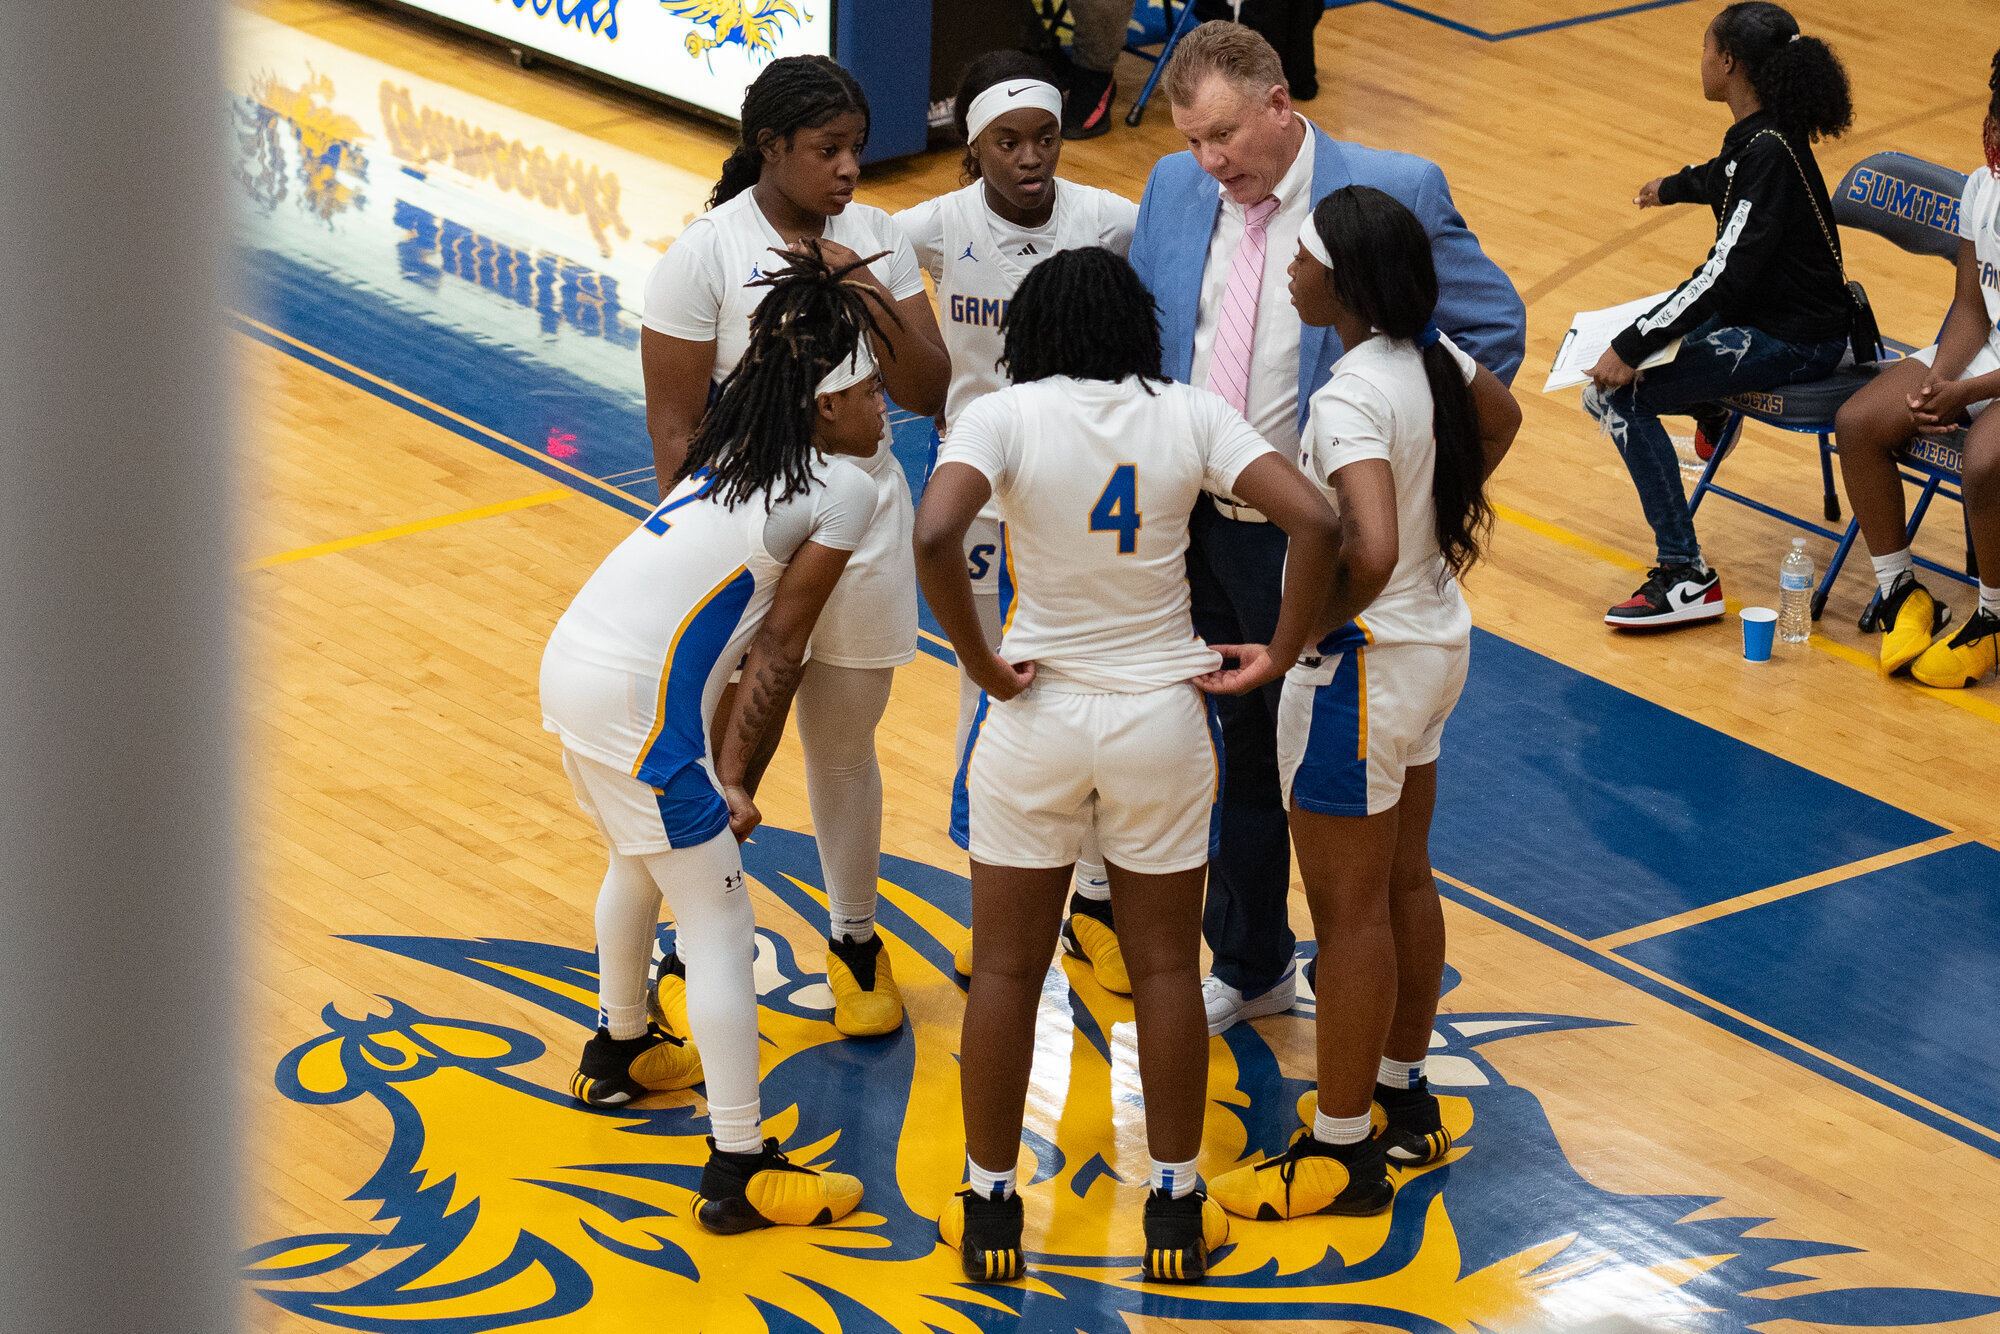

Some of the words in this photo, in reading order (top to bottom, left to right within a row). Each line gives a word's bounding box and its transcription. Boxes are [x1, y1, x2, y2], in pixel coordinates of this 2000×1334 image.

[1847, 167, 1961, 237] SUMTER
[1687, 276, 1709, 299] NIKE
[1088, 462, 1143, 556] 4
[967, 543, 997, 580] S
